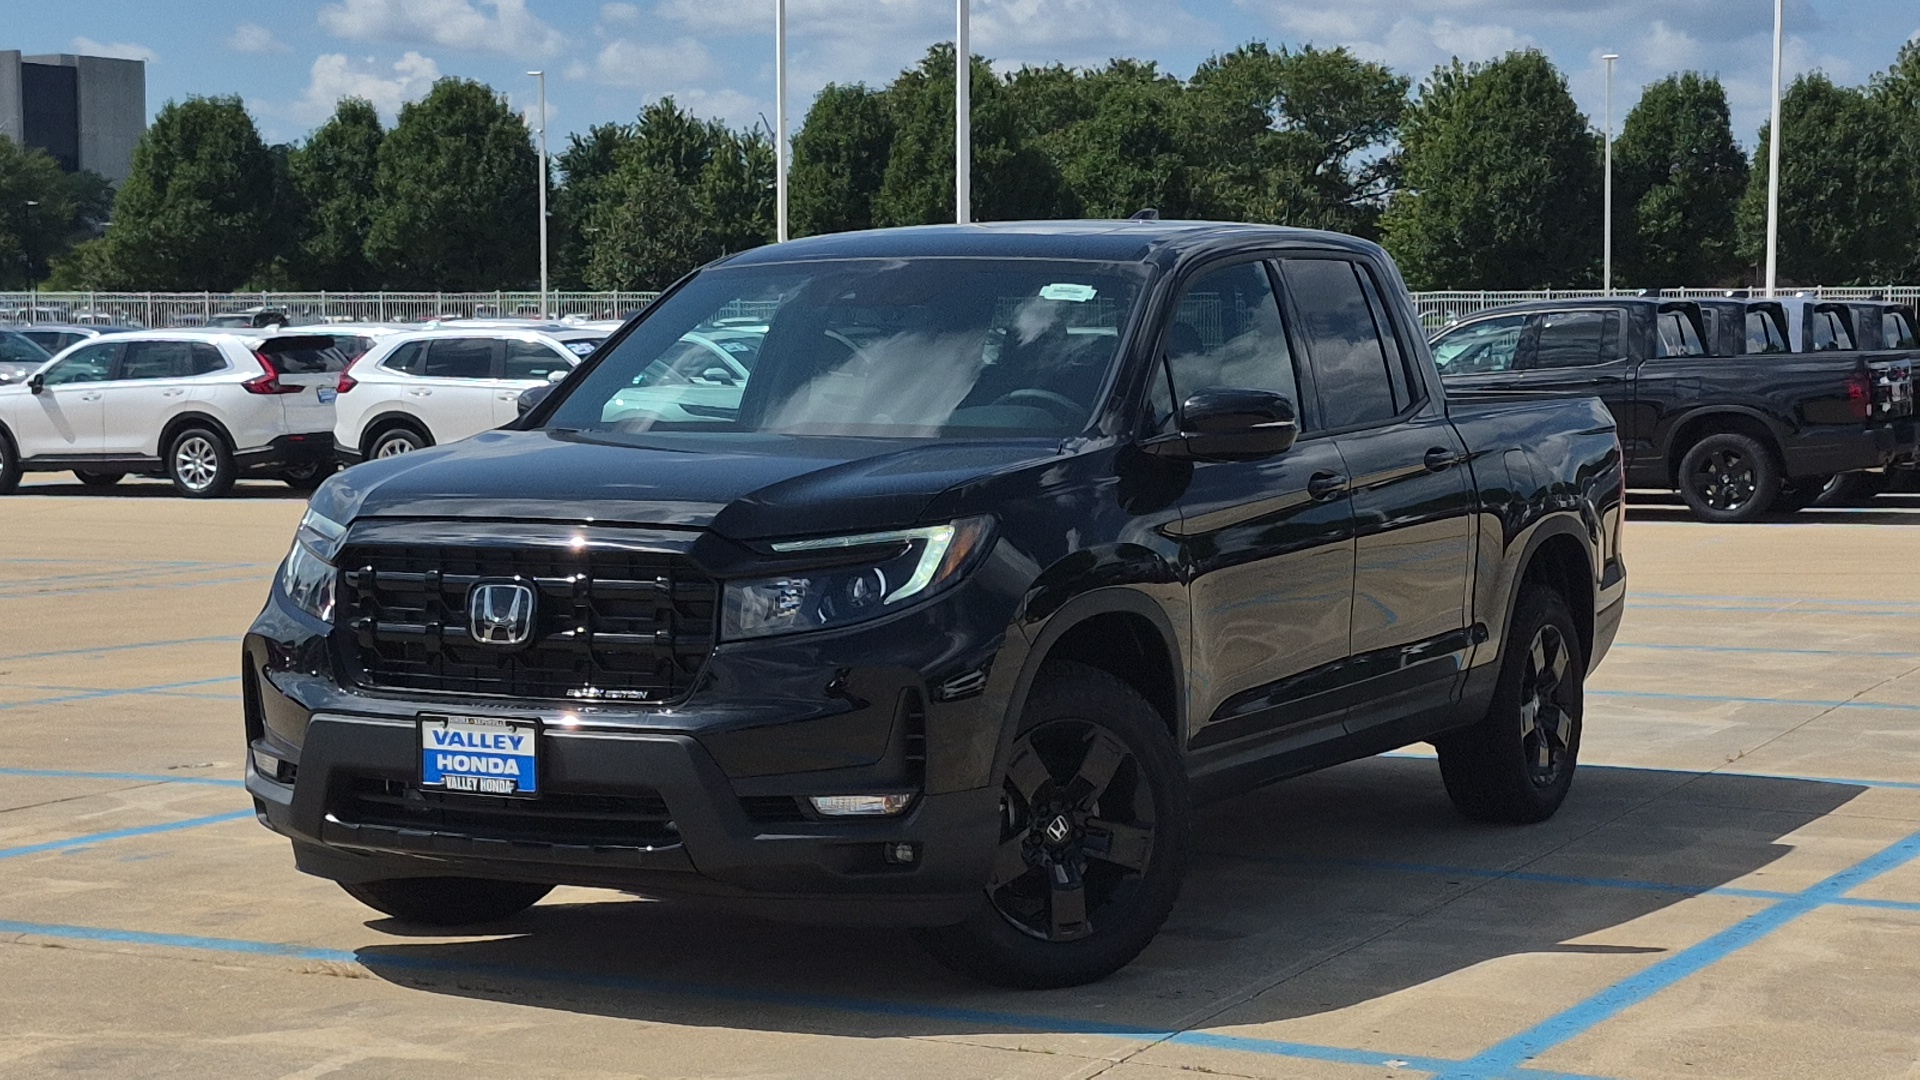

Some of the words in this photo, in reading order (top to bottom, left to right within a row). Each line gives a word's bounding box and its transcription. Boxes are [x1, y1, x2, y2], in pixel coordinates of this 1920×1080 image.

[432, 729, 525, 751] VALLEY
[436, 753, 520, 776] HONDA
[445, 775, 479, 792] VALLEY
[480, 777, 514, 794] HONDA
